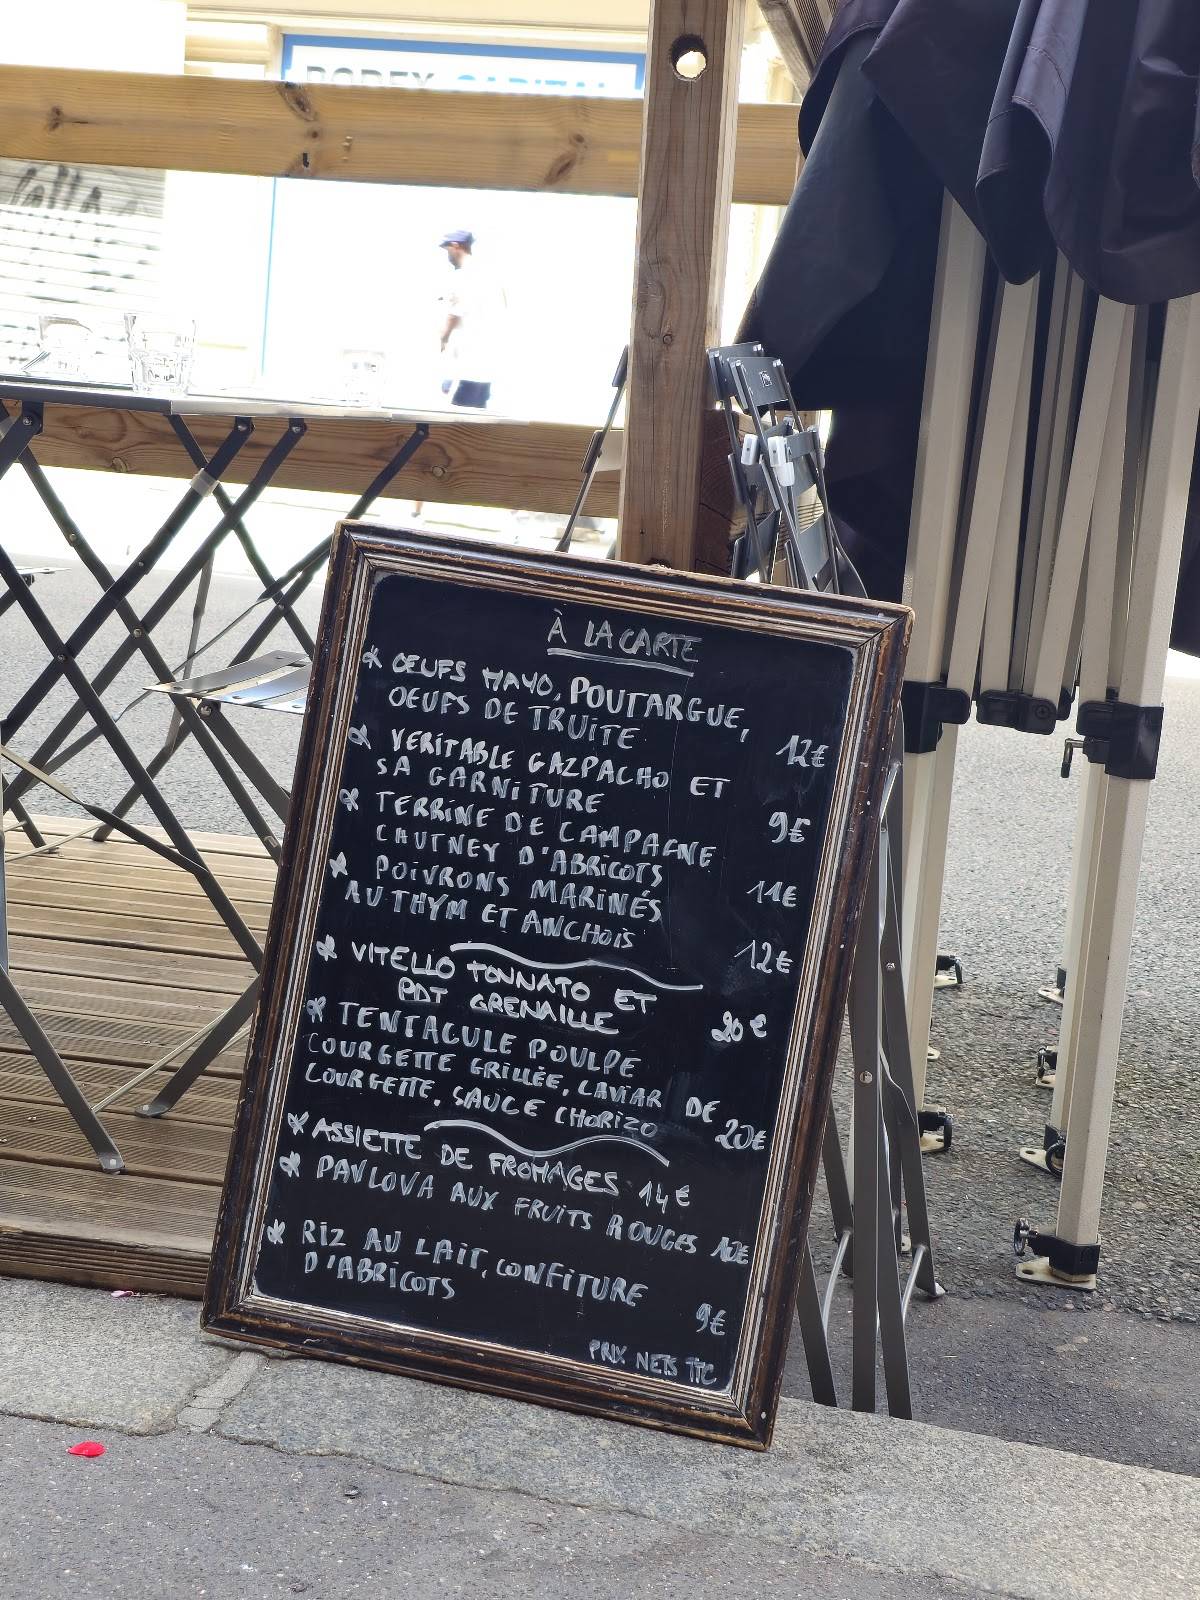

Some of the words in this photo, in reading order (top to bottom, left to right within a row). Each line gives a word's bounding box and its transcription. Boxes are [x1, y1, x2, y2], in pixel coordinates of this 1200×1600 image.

[484, 697, 519, 725] DE
[570, 676, 750, 743] POUTARGUE,
[376, 755, 411, 776] SA
[528, 750, 670, 790] GAZPACHO
[689, 775, 732, 799] ET
[504, 811, 544, 836] DE
[768, 811, 811, 844] 9€
[344, 880, 384, 907] AU
[391, 889, 468, 921] THYM
[481, 903, 518, 929] ET
[746, 880, 798, 908] 11€
[733, 939, 795, 974] 12€
[351, 941, 456, 980] VITELLO
[466, 960, 591, 1002] TONNATO
[614, 988, 659, 1014] ET
[398, 976, 449, 1004] PDT
[469, 992, 619, 1035] GRENAILLE
[337, 1001, 518, 1054] TENTACULE
[528, 1038, 642, 1078] POULPE
[453, 1085, 546, 1117] SAUCE
[685, 1096, 721, 1123] DE
[312, 1117, 422, 1160] ASSIETTE
[441, 1143, 473, 1170] DE
[714, 1118, 768, 1151] 20€
[316, 1154, 434, 1199] PAVLOVA
[450, 1181, 500, 1211] AUX
[362, 1227, 402, 1253] AU
[695, 1302, 727, 1336] 9€
